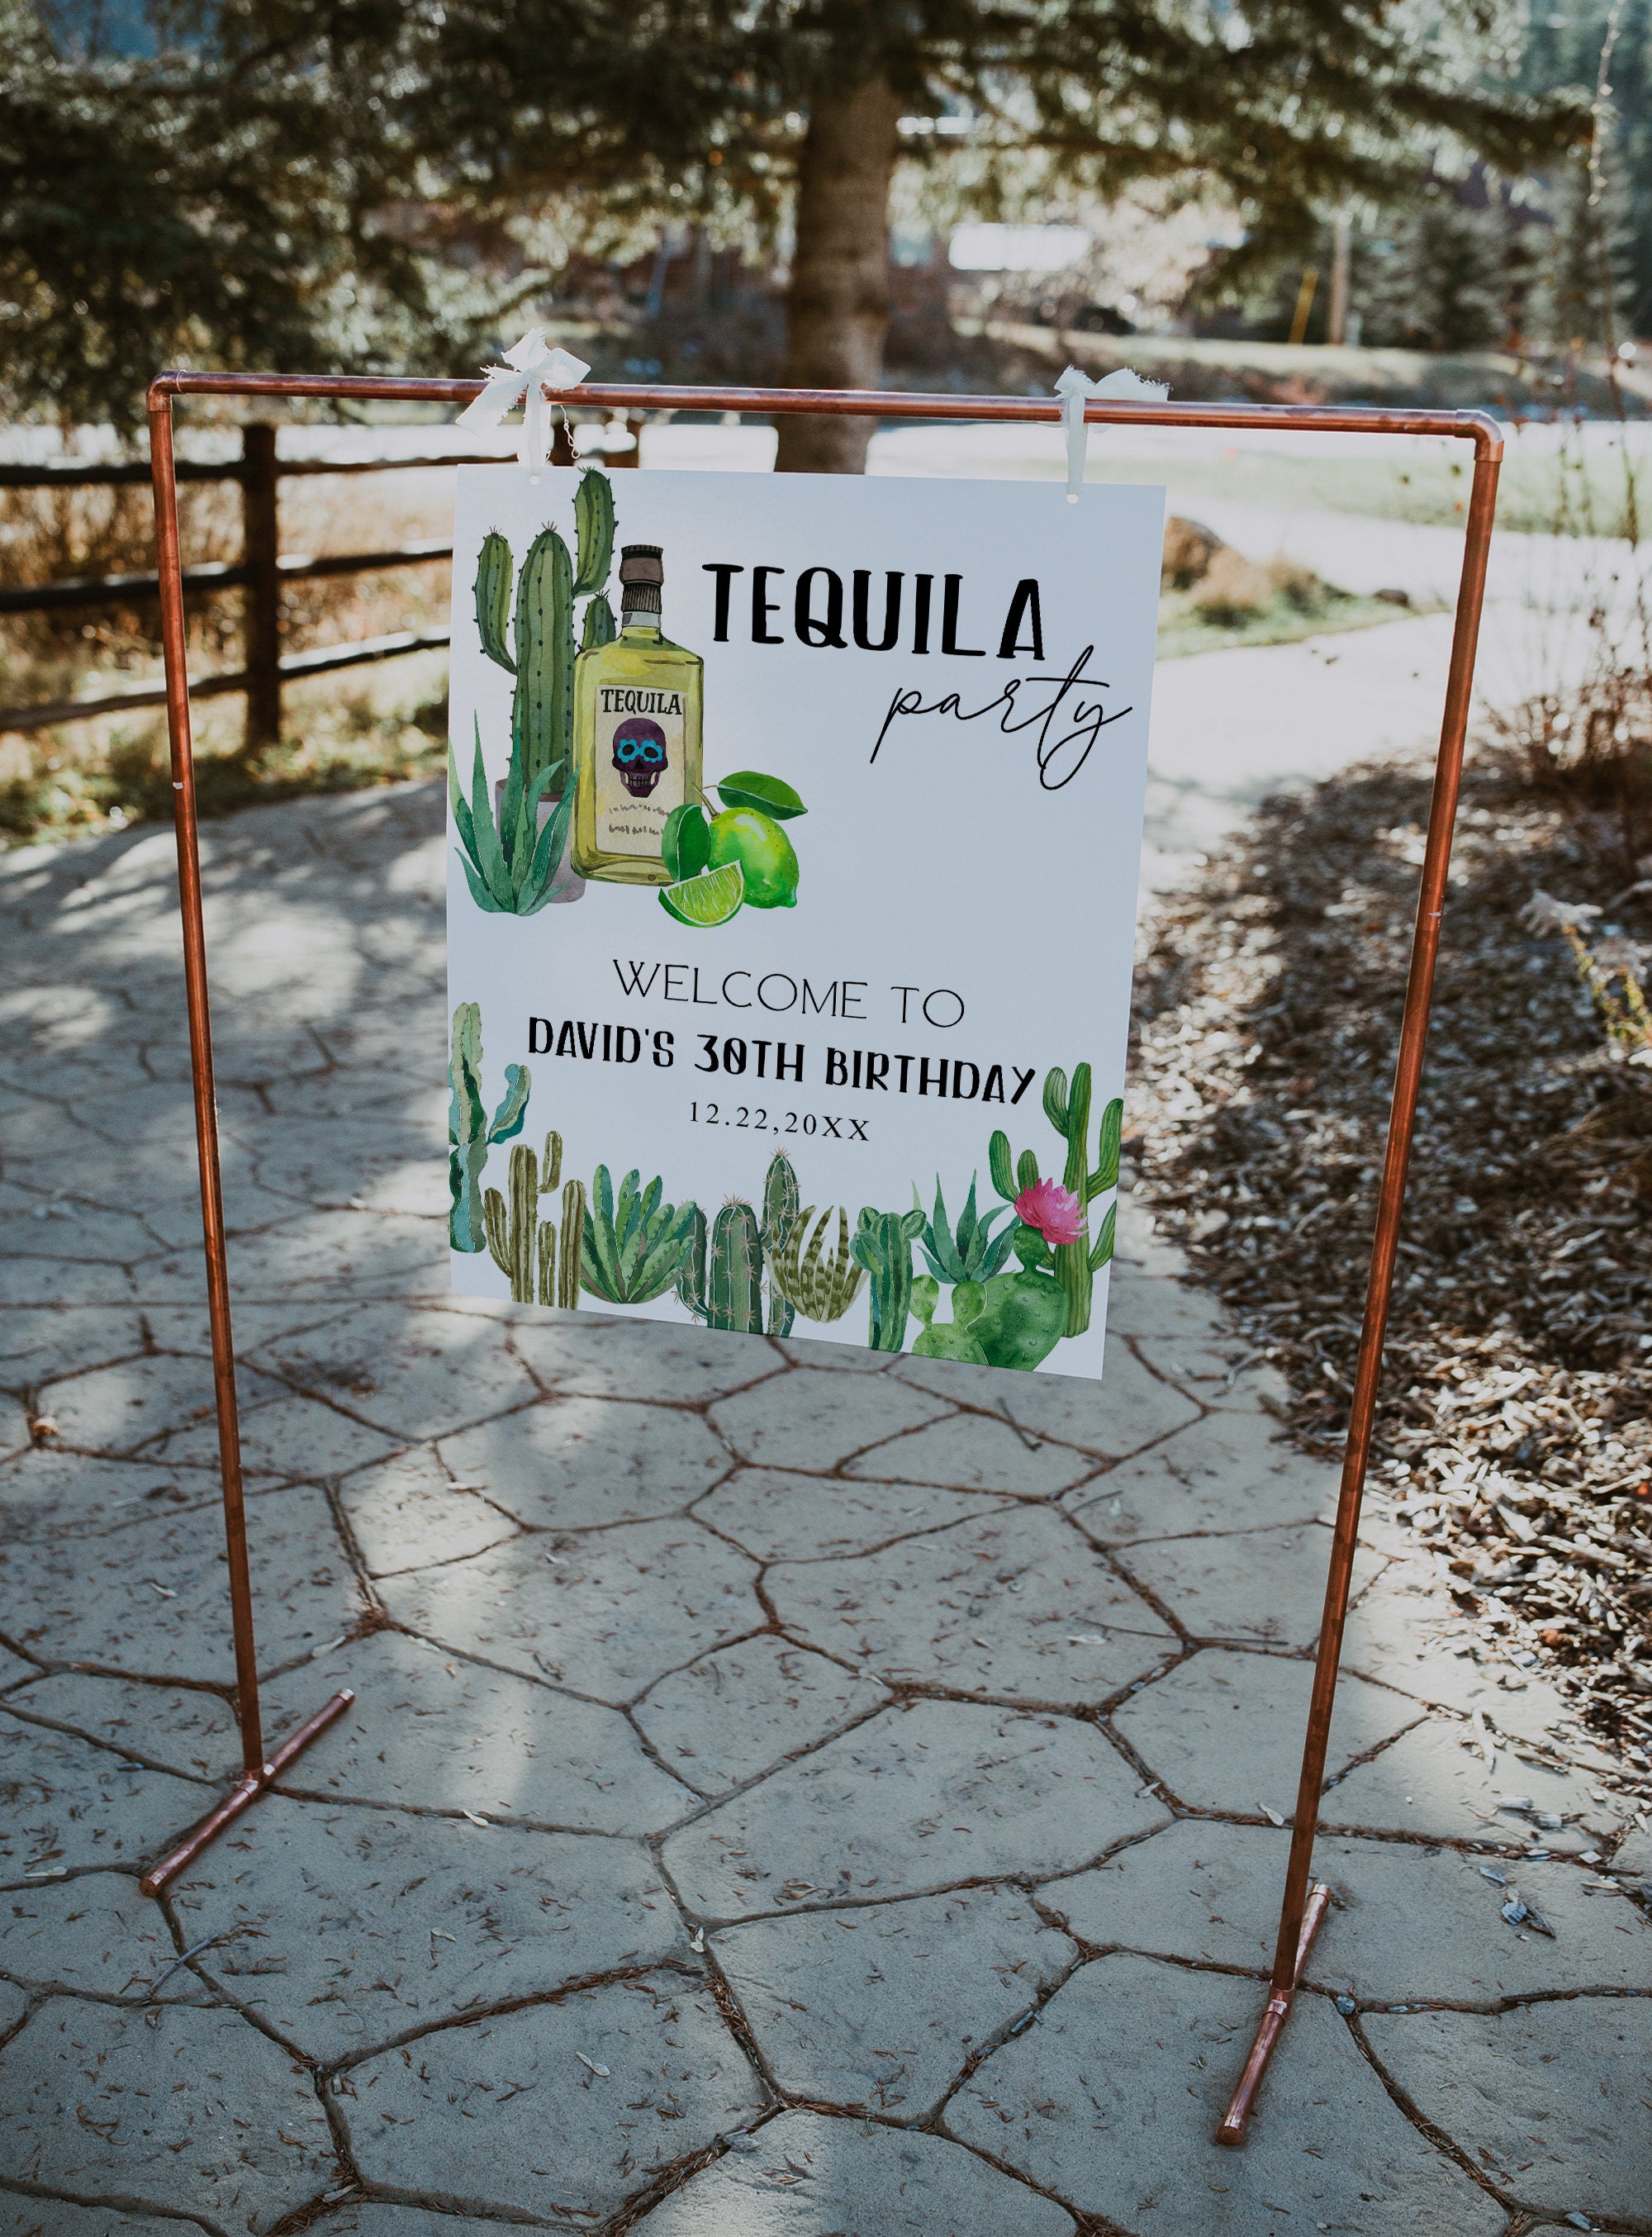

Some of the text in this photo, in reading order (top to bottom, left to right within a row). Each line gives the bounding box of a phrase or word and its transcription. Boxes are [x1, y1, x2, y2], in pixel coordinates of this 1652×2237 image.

[701, 563, 1046, 661] TEQUILA
[601, 688, 683, 715] TEQUILA
[869, 644, 1133, 791] party
[612, 959, 965, 1028] WELCOME TO
[529, 1016, 1036, 1105] DAVID'S 30TH BIRTHDAY
[689, 1101, 871, 1142] 12.22,20XX
